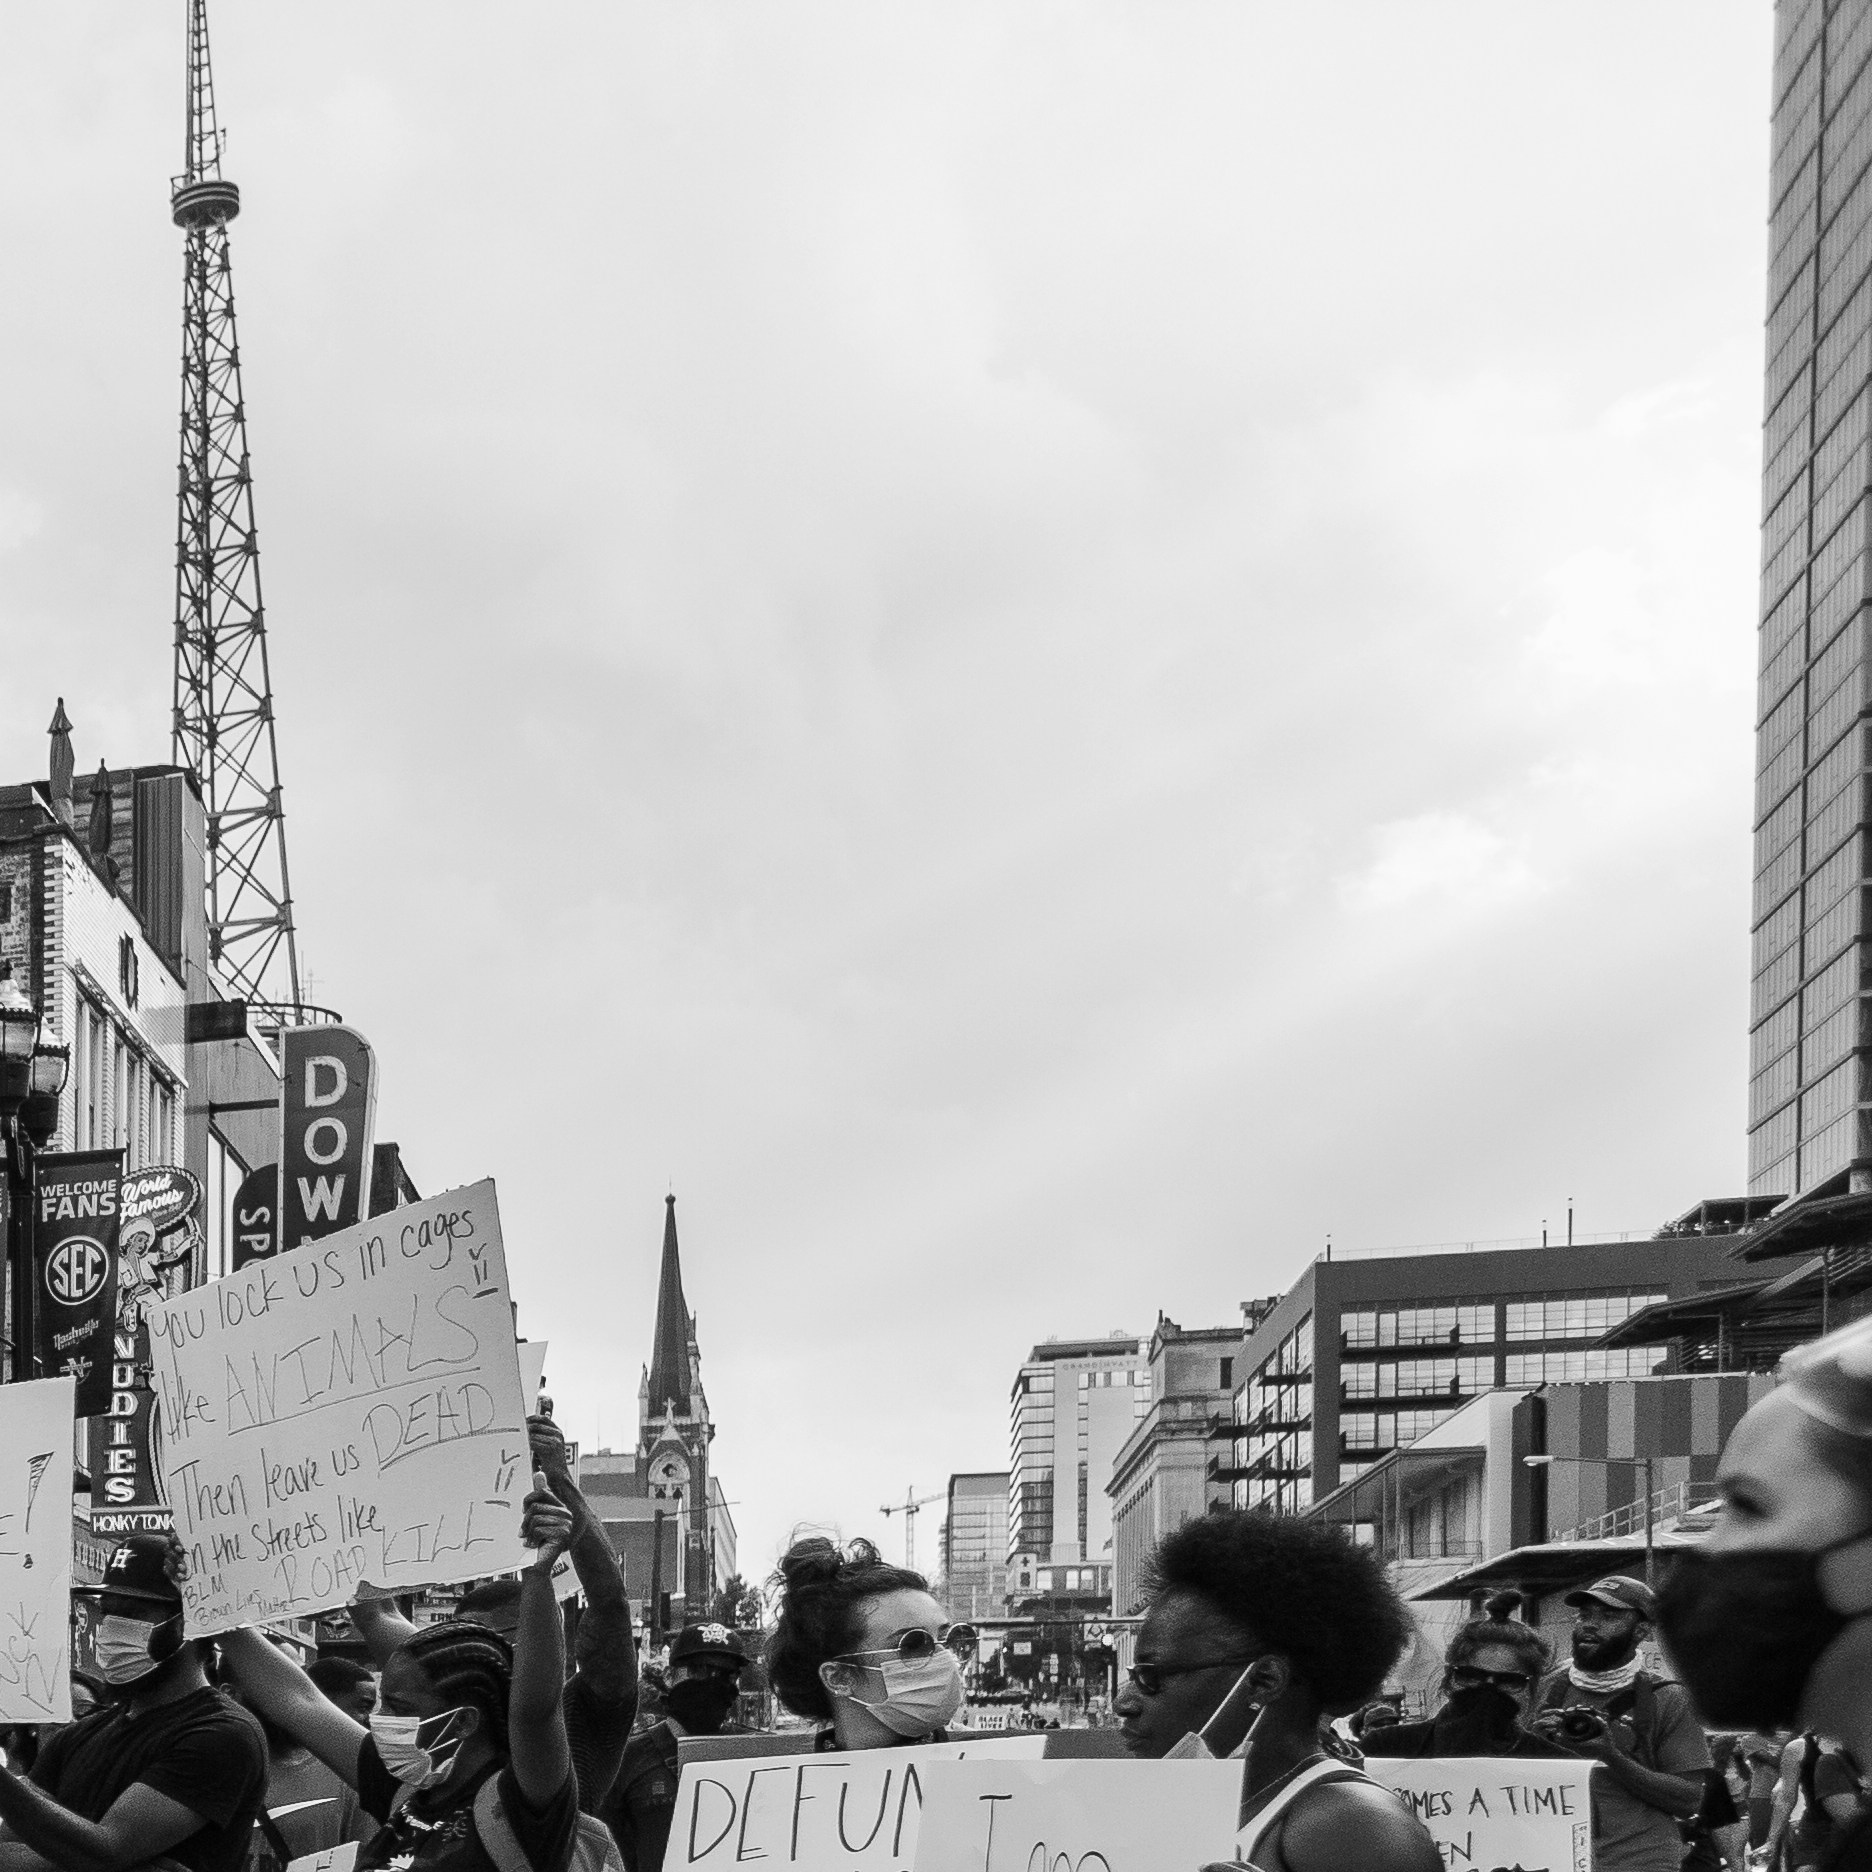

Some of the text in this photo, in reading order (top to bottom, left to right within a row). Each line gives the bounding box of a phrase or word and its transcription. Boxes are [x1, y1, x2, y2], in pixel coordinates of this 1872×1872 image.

[297, 1055, 347, 1246] DOW
[39, 1180, 118, 1198] WELCOME
[40, 1192, 117, 1222] FANS
[119, 1188, 185, 1225] Famous
[121, 1172, 173, 1203] World
[240, 1206, 270, 1268] SP
[51, 1243, 103, 1298] SEC
[218, 1270, 284, 1329] lock
[358, 1233, 388, 1281] in
[399, 1208, 476, 1271] cages
[225, 1286, 480, 1428] ANIMALS
[169, 1459, 248, 1534] Then
[261, 1447, 325, 1509] leave
[361, 1382, 496, 1467] DEAD
[92, 1513, 176, 1532] HONKY TONK
[687, 1763, 924, 1864] DEFUN
[1468, 1787, 1490, 1819] A
[1499, 1784, 1576, 1815] TIME
[1436, 1831, 1472, 1866] EN
